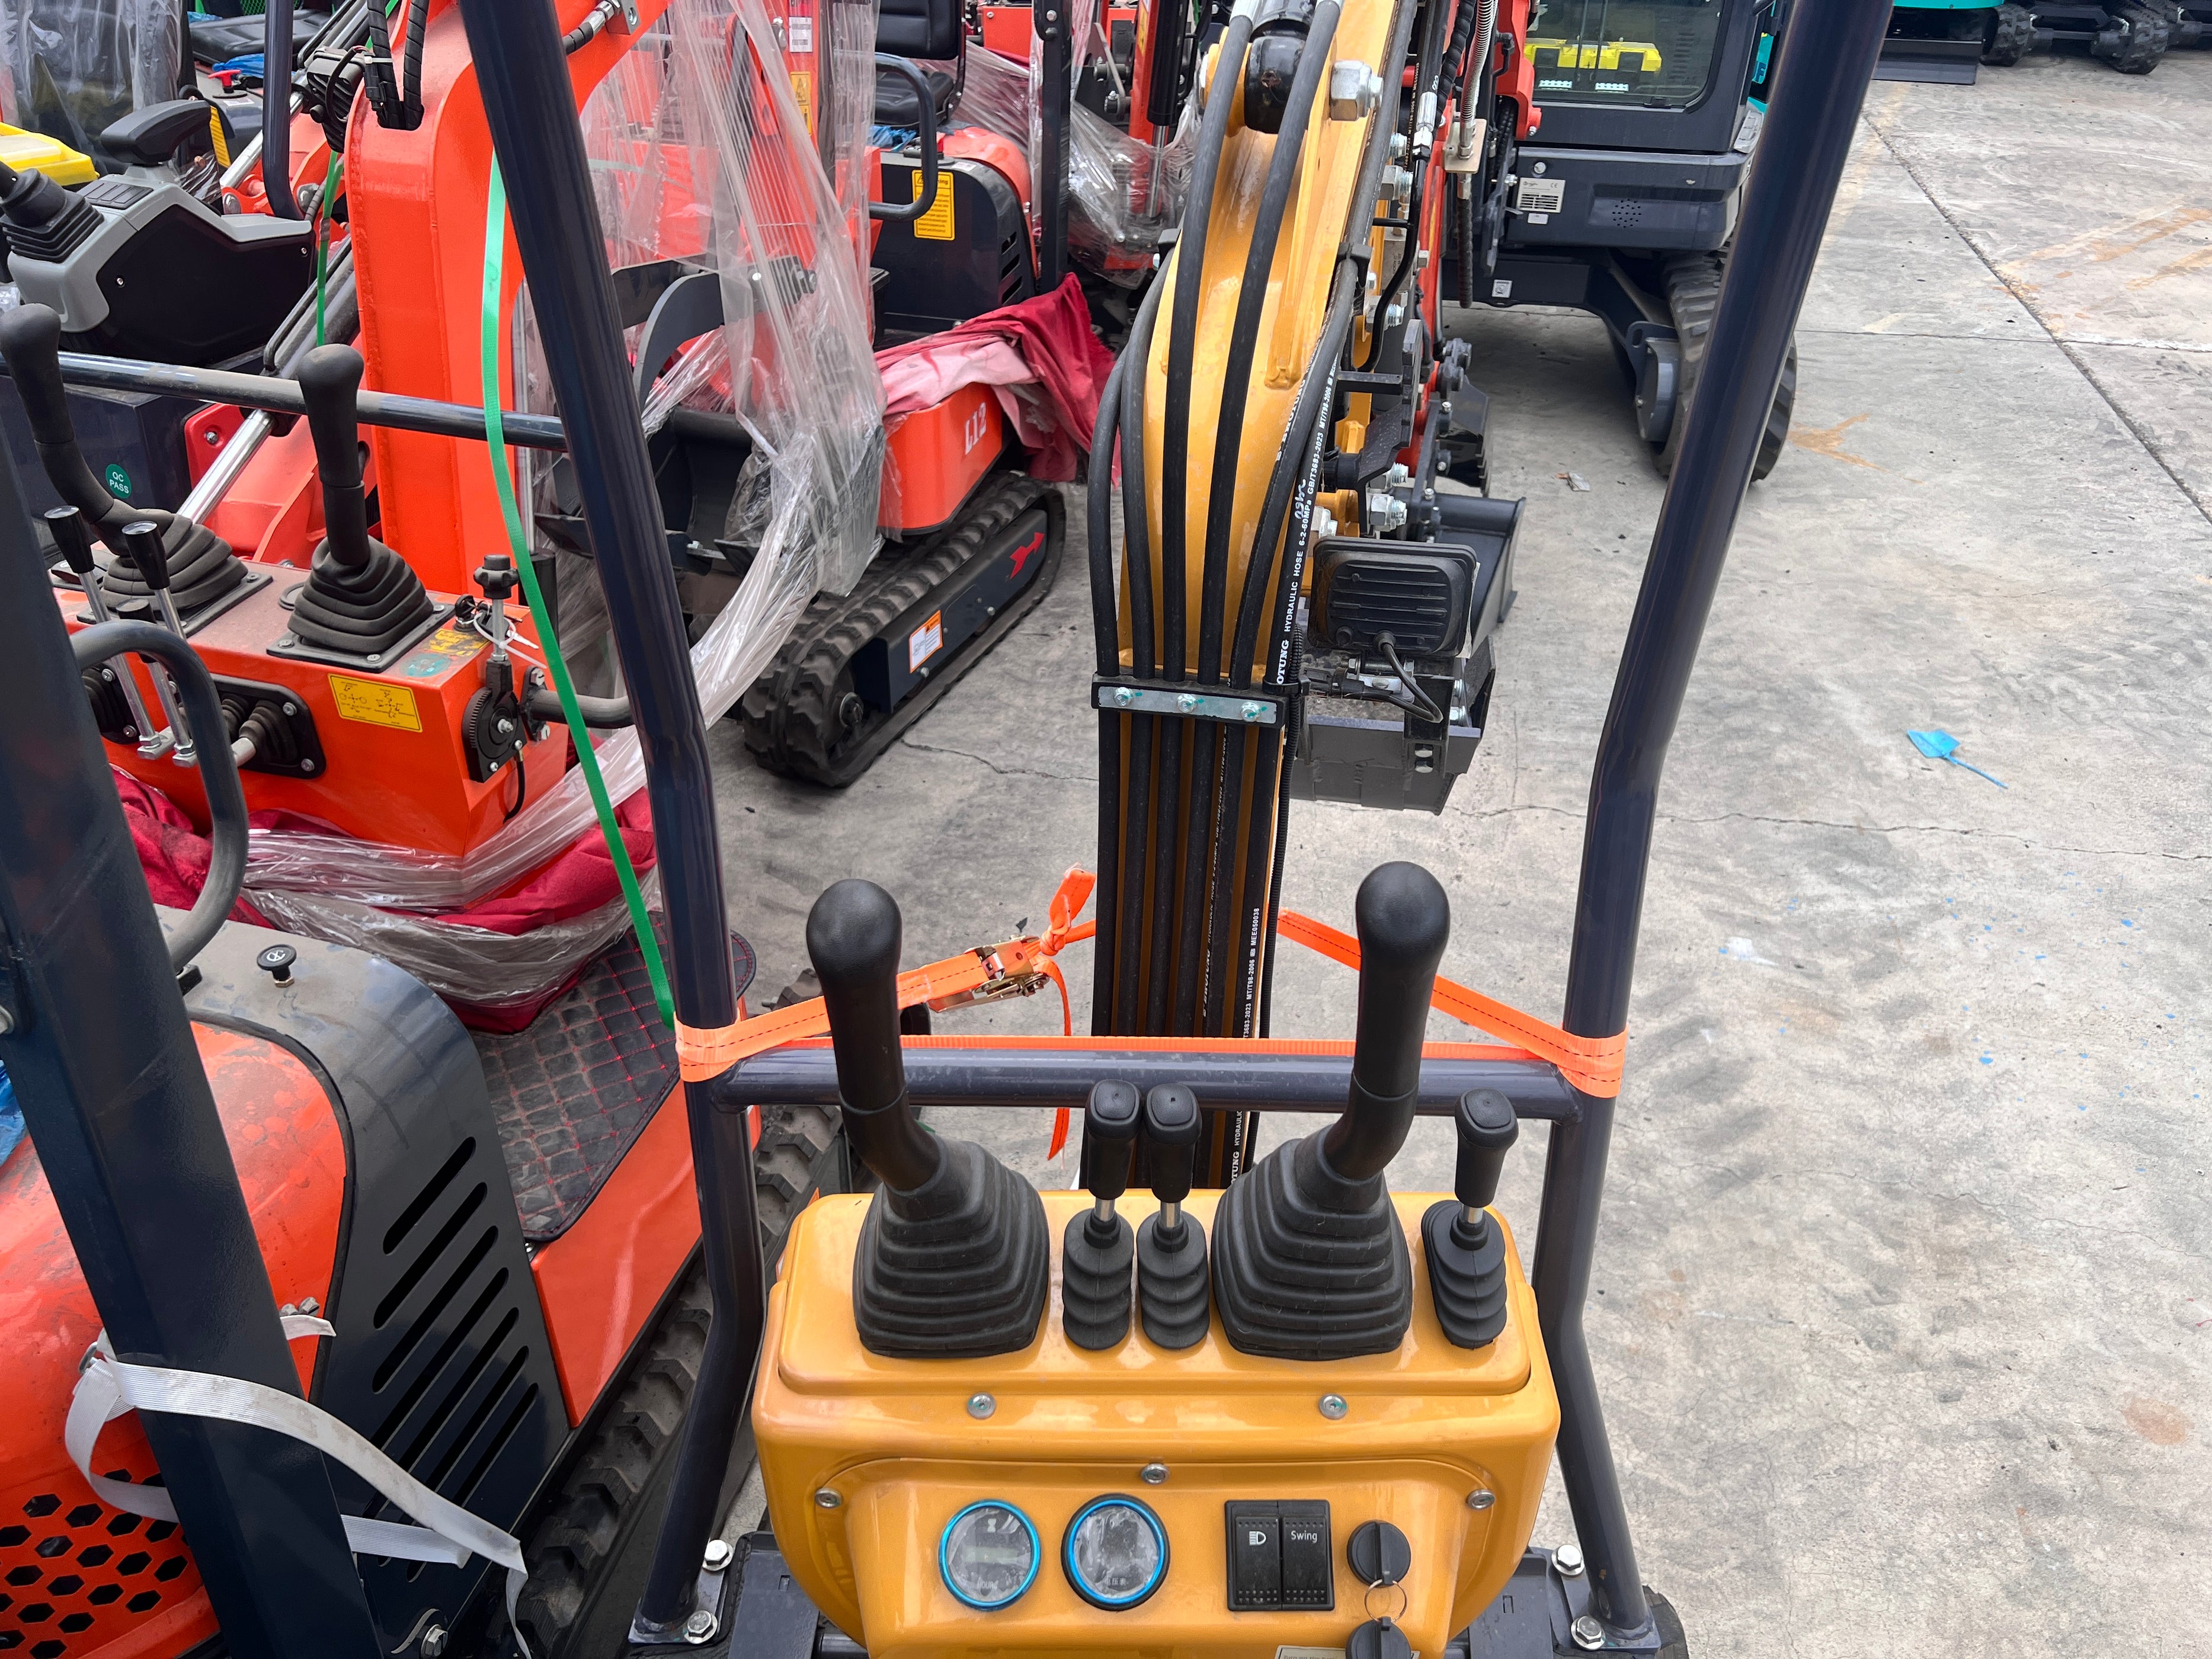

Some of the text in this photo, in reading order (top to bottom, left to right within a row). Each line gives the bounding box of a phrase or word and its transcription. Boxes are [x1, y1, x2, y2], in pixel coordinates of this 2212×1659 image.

[965, 402, 987, 455] L12
[110, 479, 129, 494] PASS
[113, 472, 124, 482] QC
[1285, 581, 1298, 632] HYDRAULIC
[1294, 550, 1304, 577] HOSE
[1299, 499, 1313, 546] 6-2-60MPa
[1308, 432, 1324, 494] GB/T3683-2023
[1319, 386, 1332, 429] MT/T98-2006
[1250, 908, 1260, 946] MEE050038
[1246, 959, 1255, 1000] MT/T98-2006
[1291, 1530, 1317, 1543] Swing
